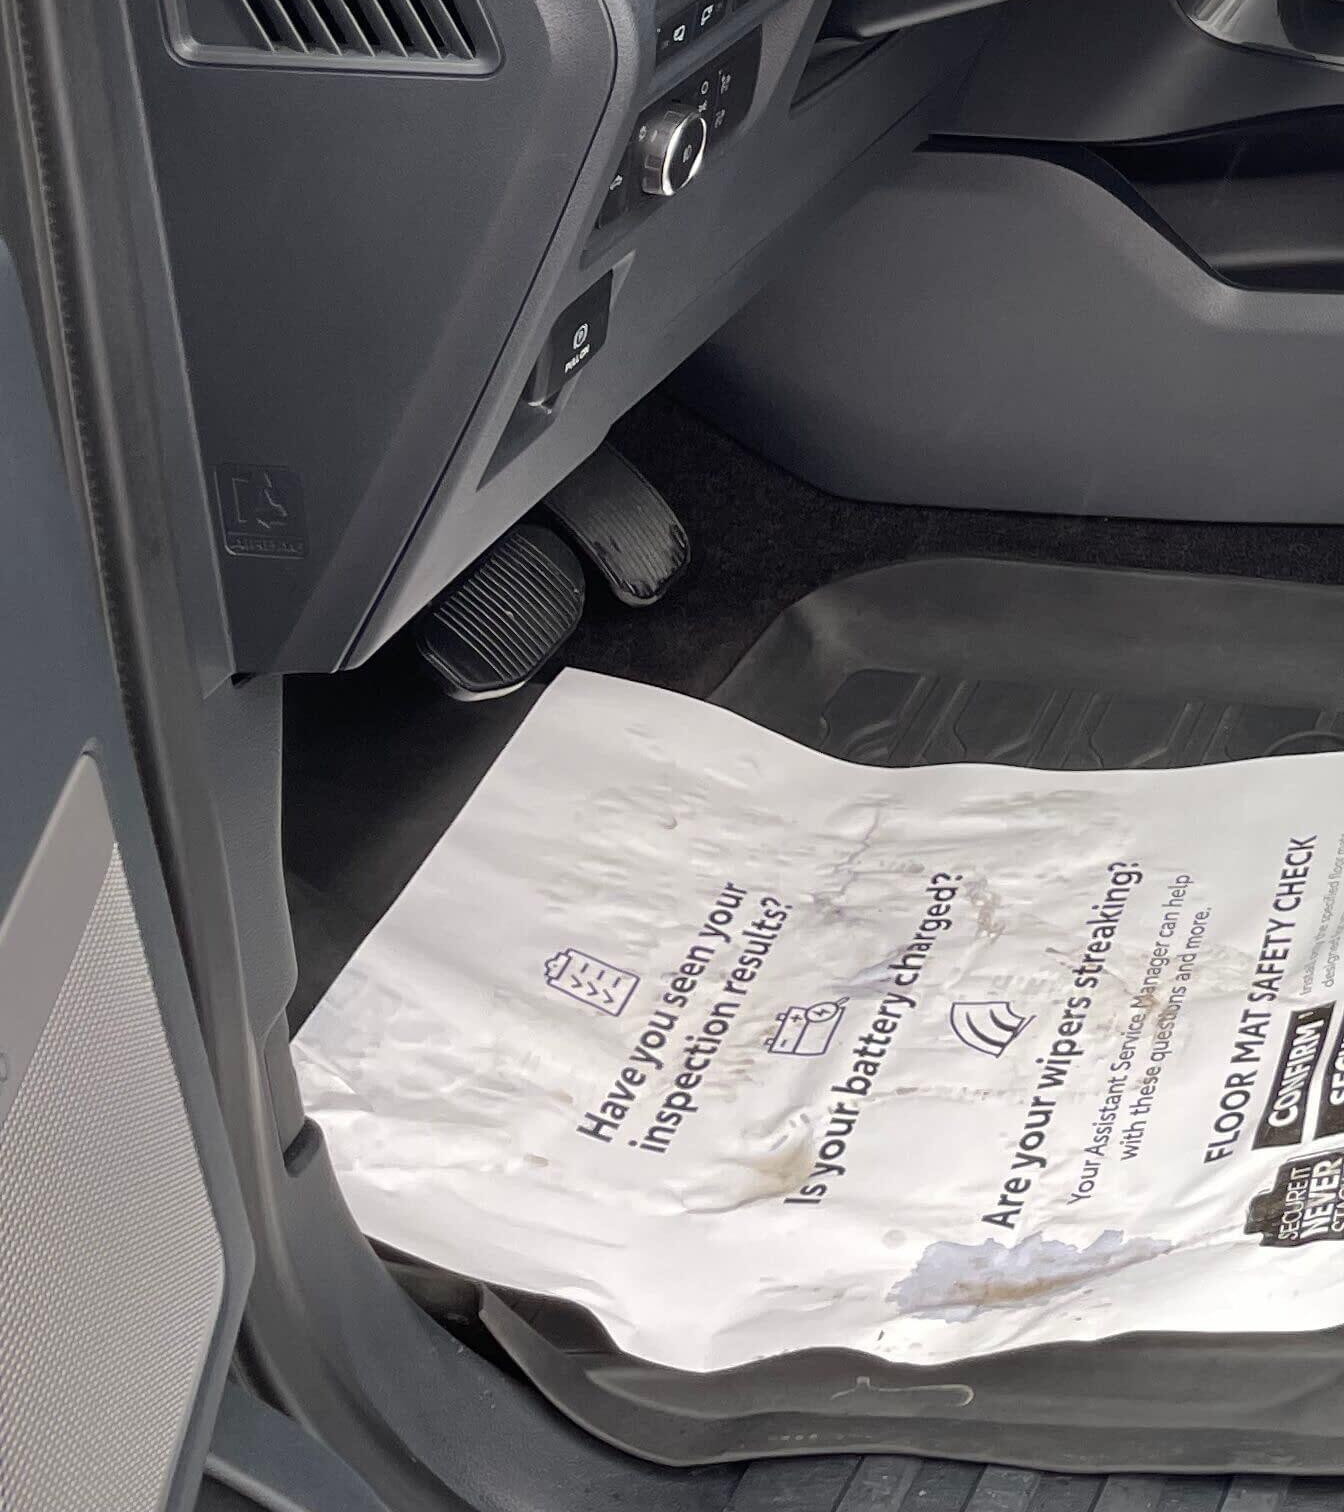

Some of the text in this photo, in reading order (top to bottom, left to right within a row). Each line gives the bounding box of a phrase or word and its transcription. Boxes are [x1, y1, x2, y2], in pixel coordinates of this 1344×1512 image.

[576, 882, 748, 1143] Have you seen your
[628, 896, 793, 1154] inspection results?
[783, 872, 964, 1205] Is your battery charged?
[981, 861, 1143, 1230] Are your wipers streaking?
[1067, 874, 1192, 1206] Your Assistant Service Manager can help
[1176, 951, 1197, 982] and
[1203, 834, 1318, 1164] FLOOR MAT SAFETY CHECK
[1120, 1117, 1147, 1162] with
[1133, 1064, 1162, 1116] these
[1268, 1018, 1325, 1128] CONFIRM
[1278, 1167, 1311, 1240] SECURE IT
[1300, 1158, 1343, 1239] NEVER
